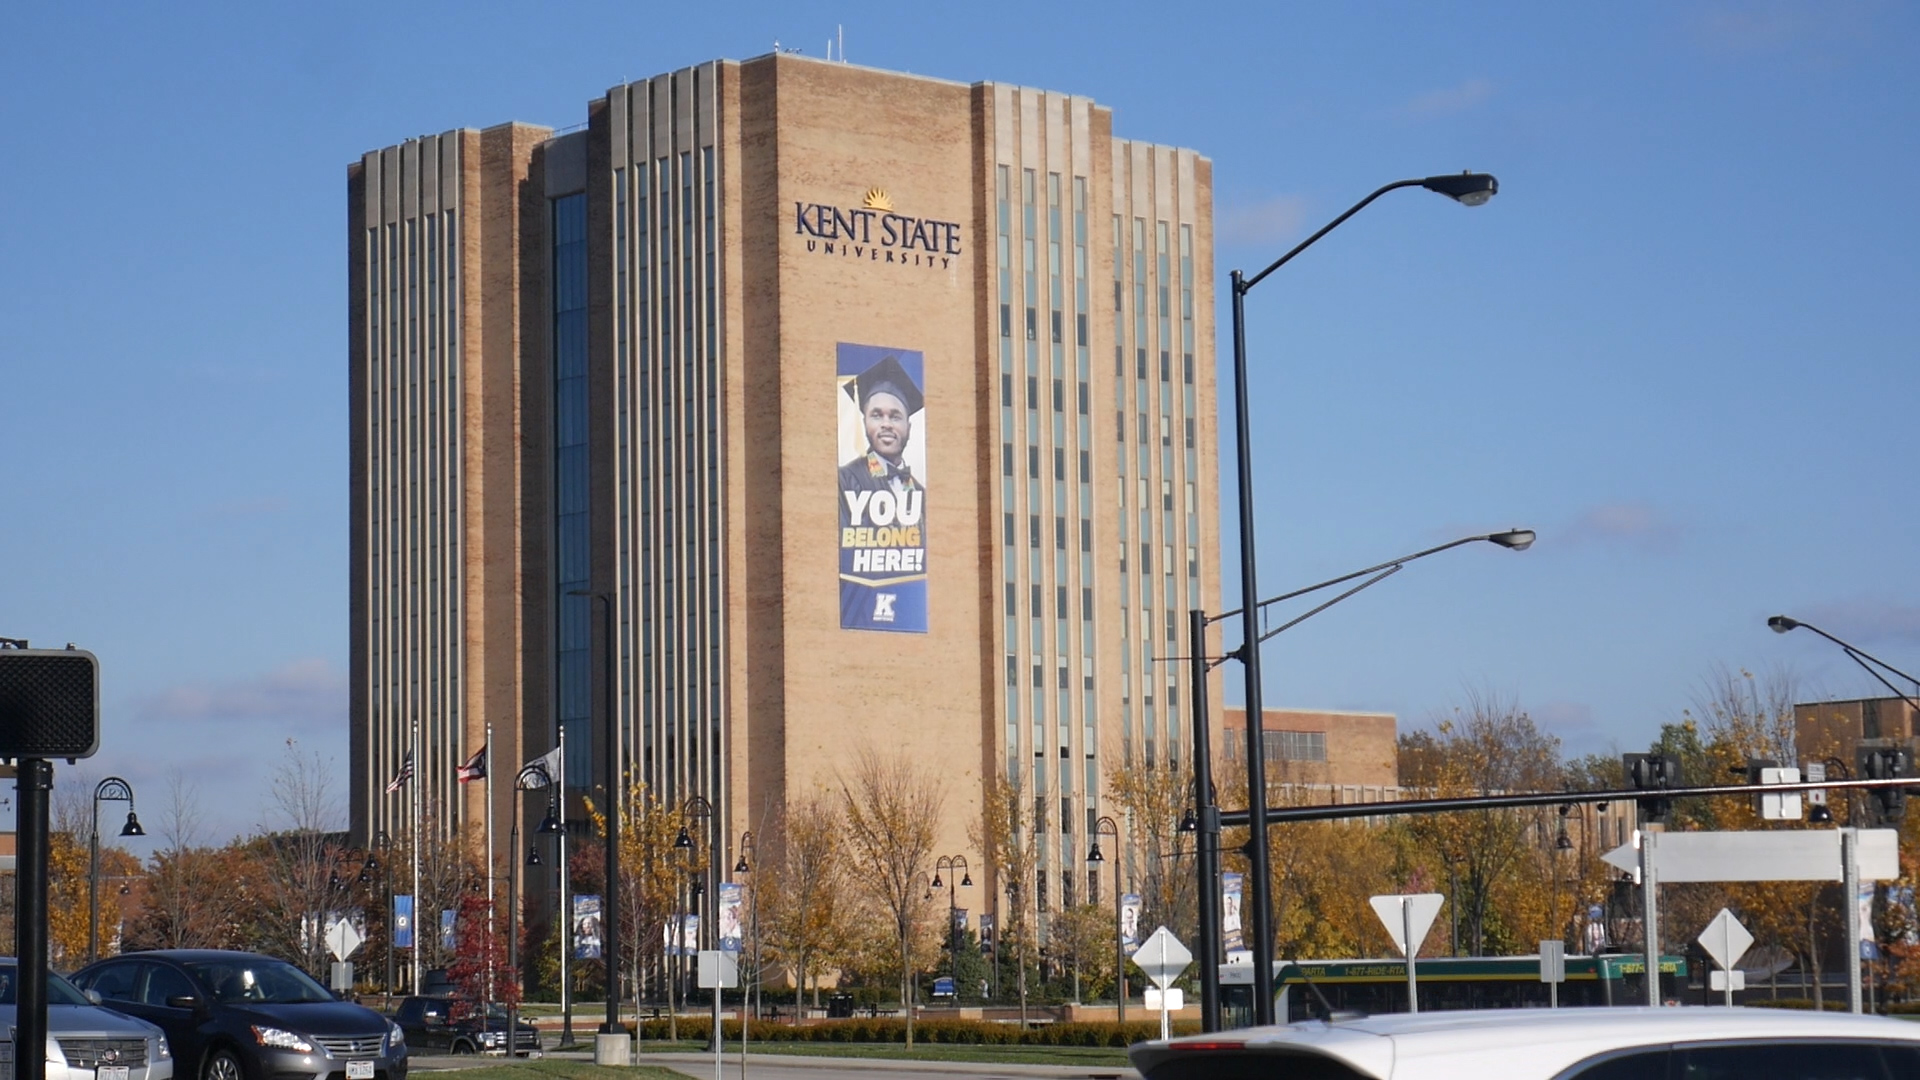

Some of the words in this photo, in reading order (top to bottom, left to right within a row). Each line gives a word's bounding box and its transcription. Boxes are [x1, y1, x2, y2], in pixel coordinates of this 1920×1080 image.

[795, 202, 876, 243] KENT
[881, 213, 962, 255] STATE
[807, 240, 950, 269] UNIVERSITY
[844, 490, 923, 526] YOU
[842, 527, 921, 548] BELONG
[853, 548, 924, 572] HERE!
[873, 592, 897, 621] K
